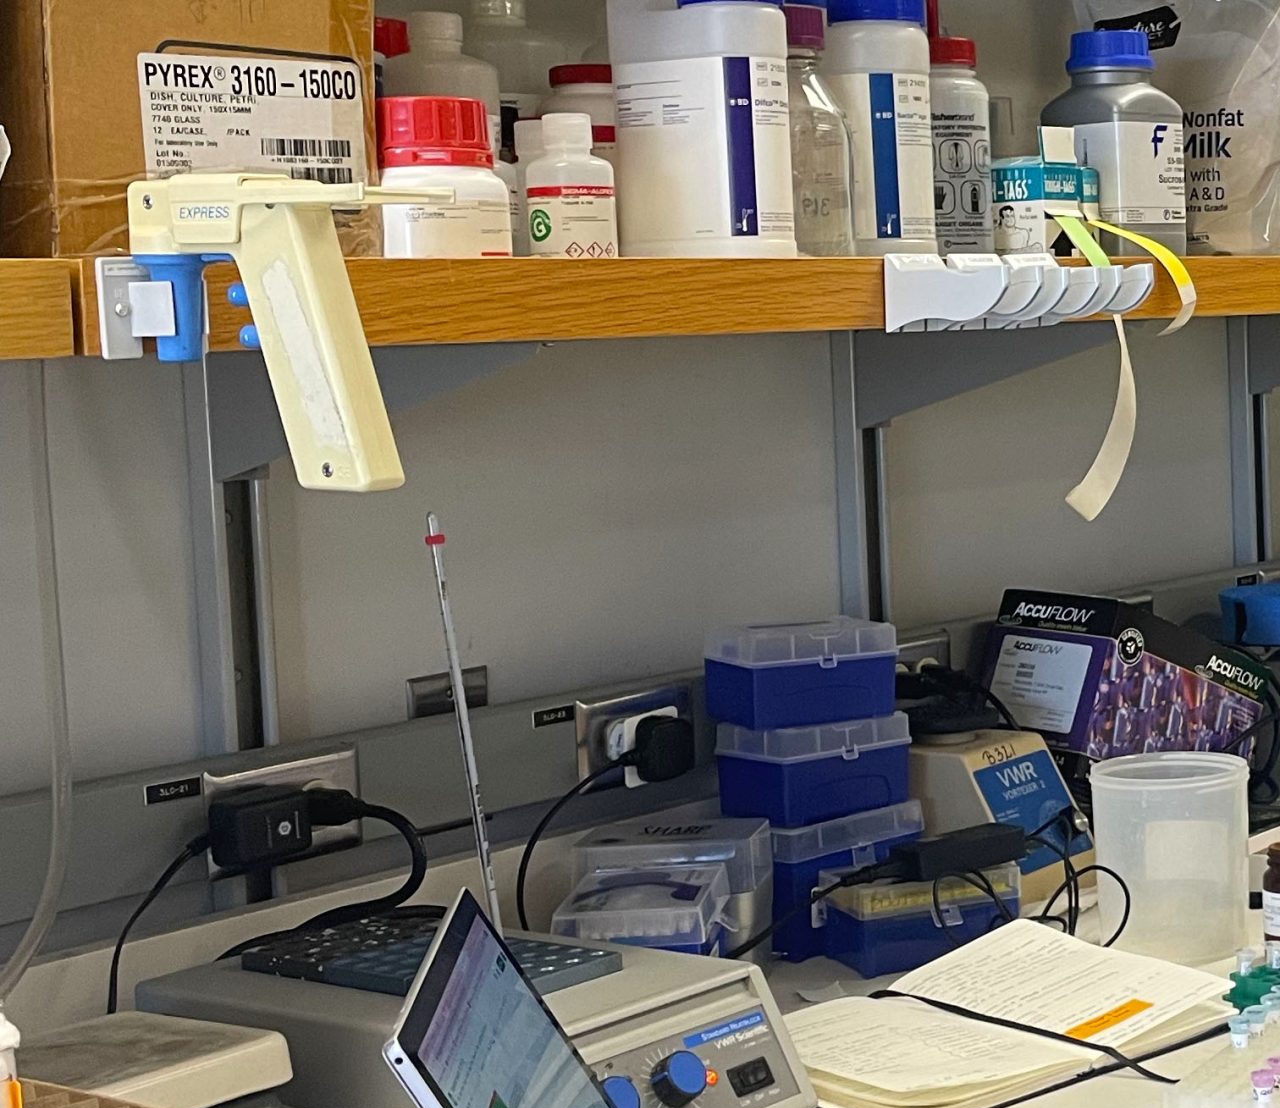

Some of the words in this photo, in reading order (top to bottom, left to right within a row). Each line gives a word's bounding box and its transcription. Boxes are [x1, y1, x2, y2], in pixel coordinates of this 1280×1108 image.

[151, 103, 178, 112] COVER
[174, 115, 201, 124] GLASS
[1182, 108, 1245, 128] Nonfat
[153, 126, 162, 134] 12
[1183, 131, 1233, 159] Milk
[156, 150, 170, 158] Lot
[1190, 167, 1221, 182] with
[1189, 187, 1199, 201] A
[1202, 187, 1212, 201] &
[1215, 186, 1225, 201] D
[178, 206, 230, 221] EXPRESS
[1012, 601, 1097, 624] ACCUFLOW
[1013, 640, 1063, 655] ACCUFLOW
[1205, 655, 1265, 690] ACCUFLOW
[995, 761, 1038, 788] VWR
[713, 1034, 737, 1050] VWR
